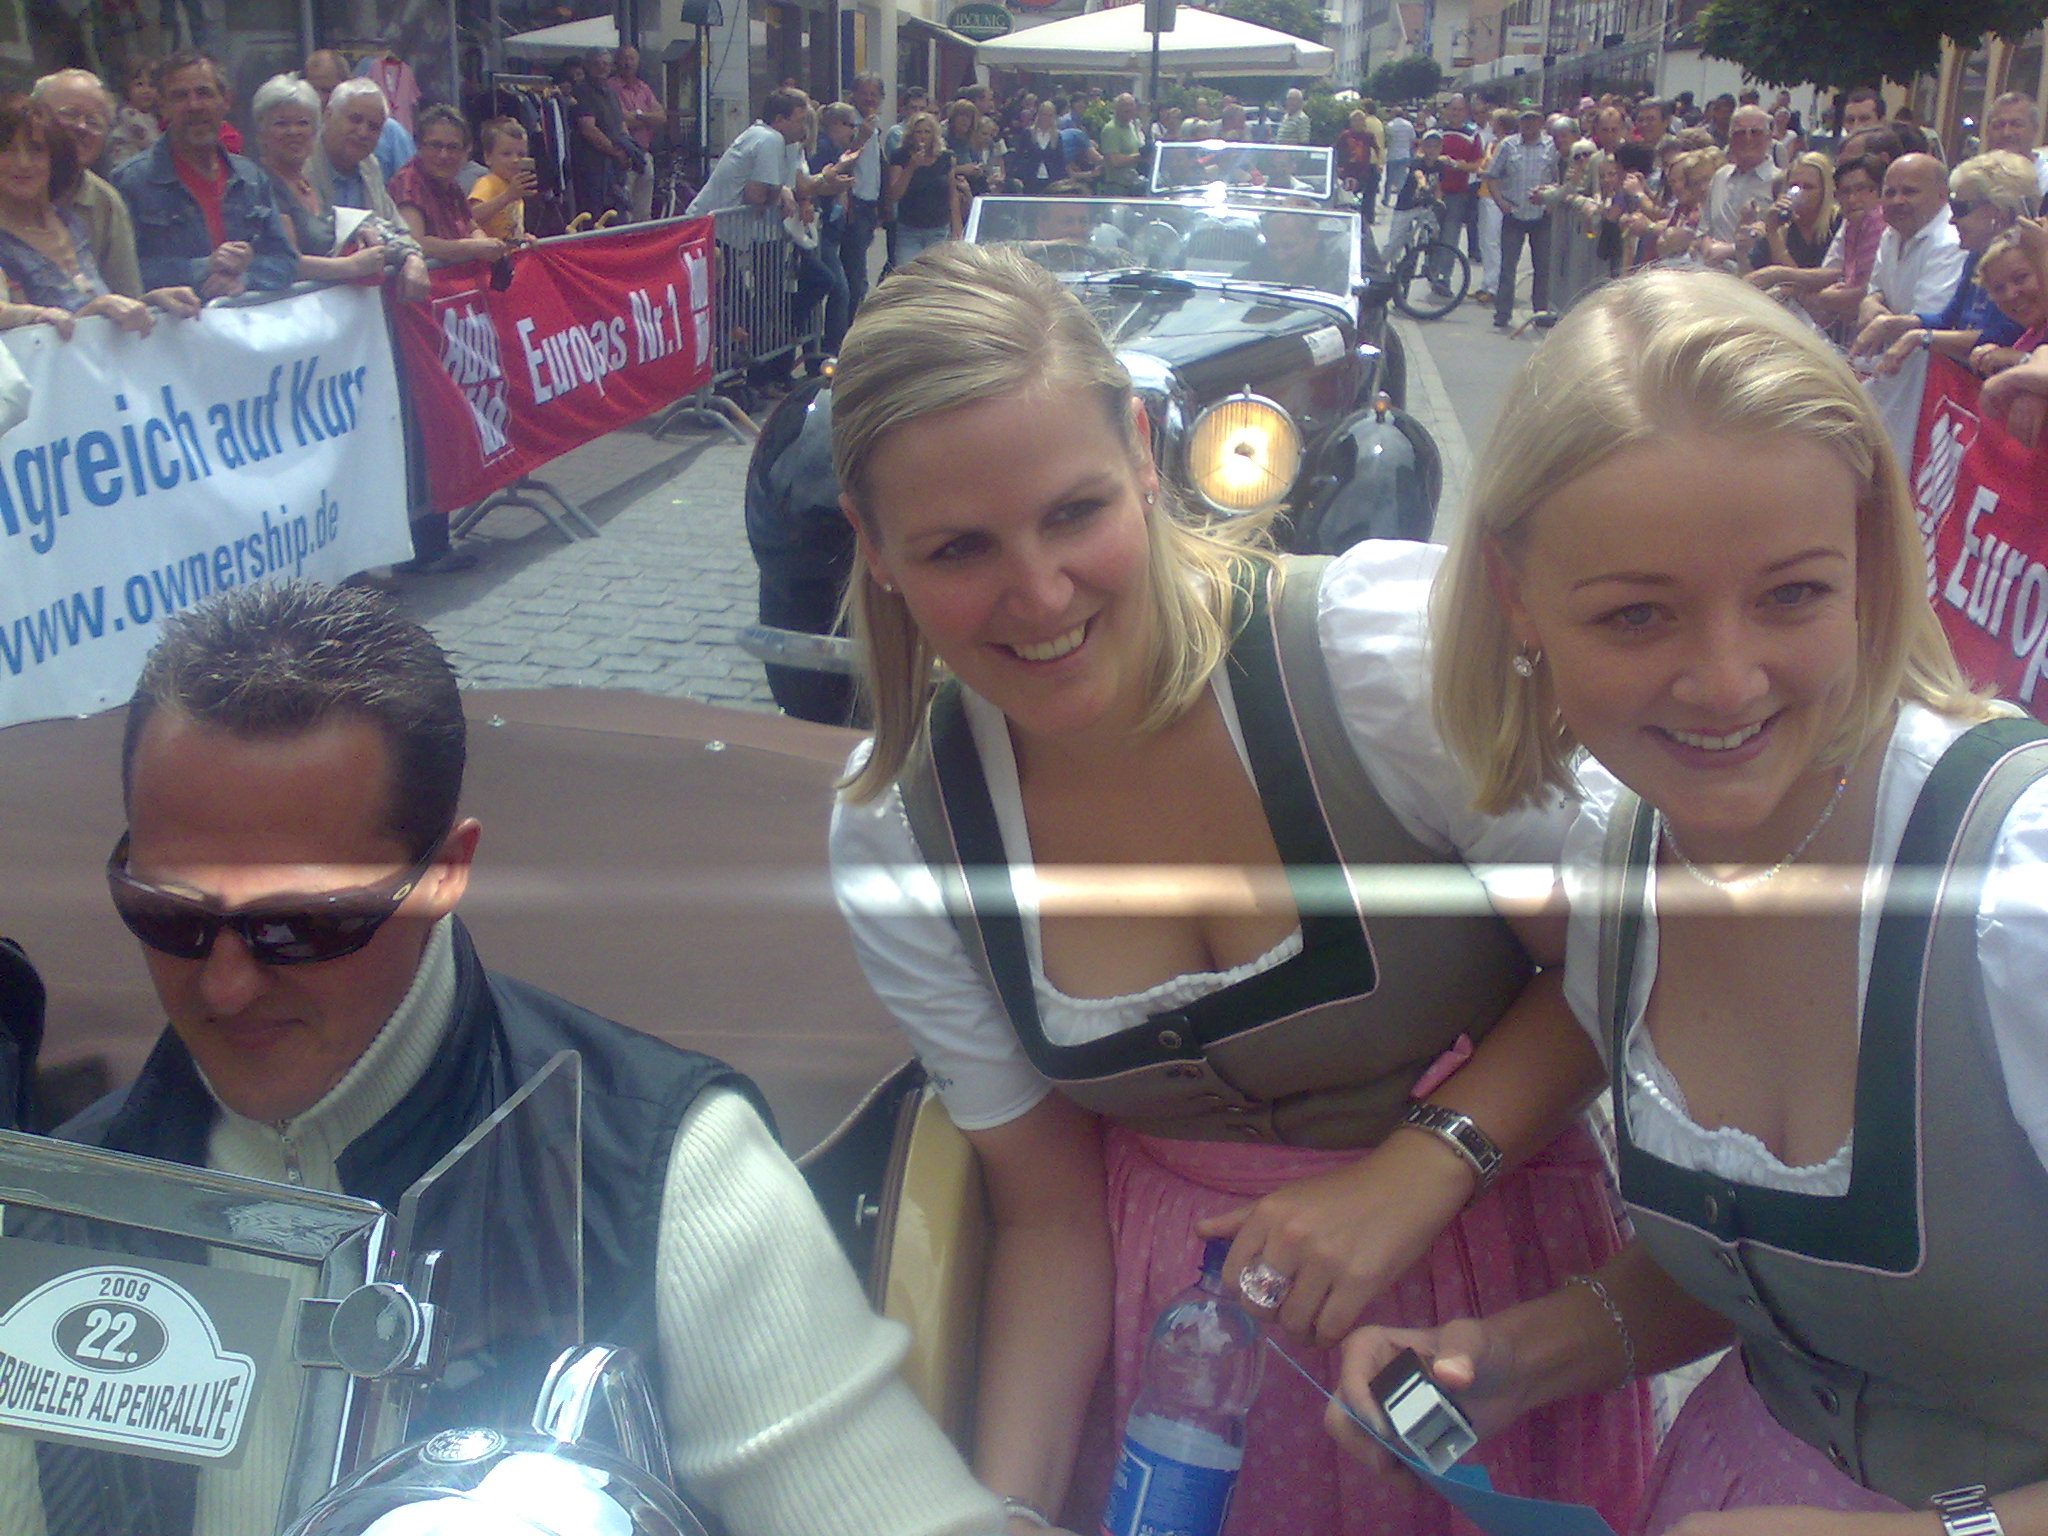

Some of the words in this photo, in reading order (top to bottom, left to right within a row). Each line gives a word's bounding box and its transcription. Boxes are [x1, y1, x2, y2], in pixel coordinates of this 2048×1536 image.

[516, 317, 627, 406] Europas
[628, 283, 683, 364] Nr.1
[207, 365, 283, 470] auf
[99, 1276, 152, 1302] 2009
[76, 1308, 139, 1364] 22.
[0, 1351, 89, 1419] BÜHELER
[87, 1375, 241, 1441] ALPENRALLYE
